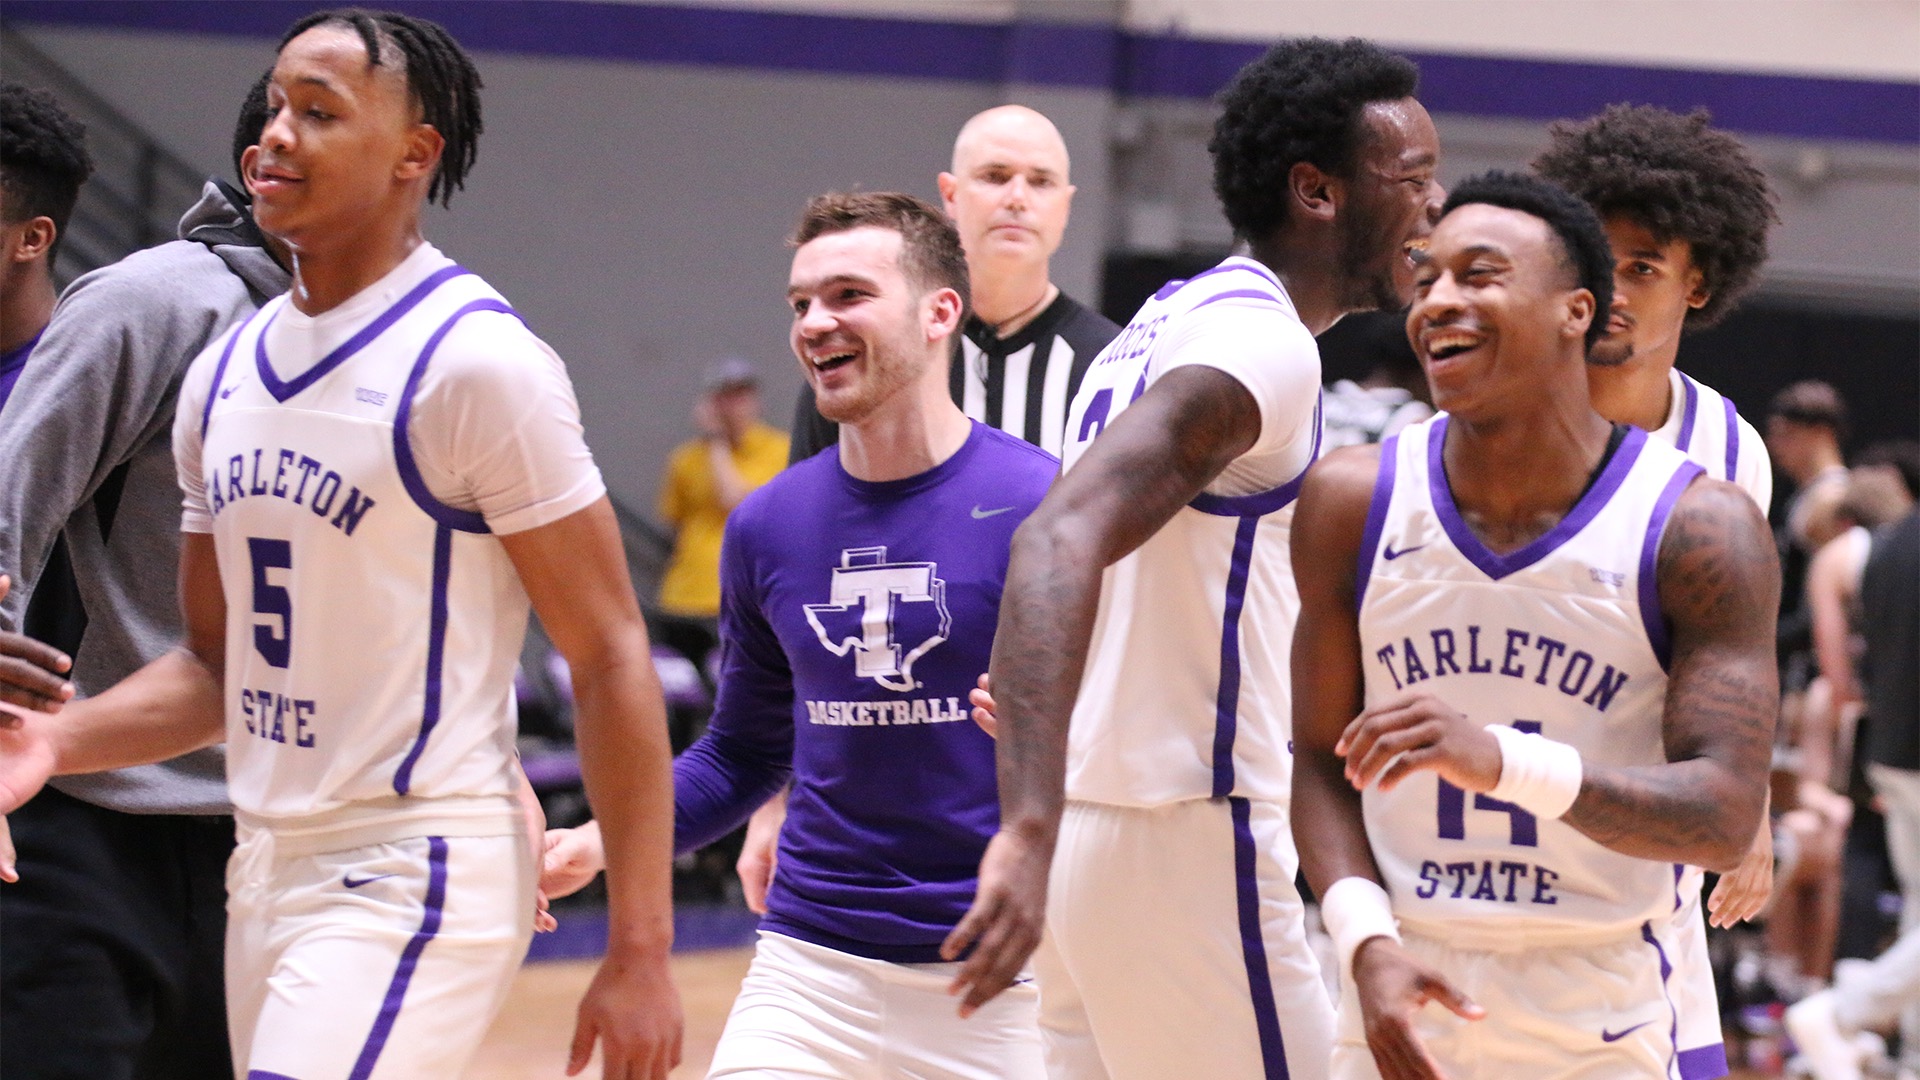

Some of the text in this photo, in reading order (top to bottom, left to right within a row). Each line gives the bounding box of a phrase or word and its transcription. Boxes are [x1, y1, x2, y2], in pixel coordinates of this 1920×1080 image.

[205, 448, 376, 537] ARLETON
[247, 537, 292, 669] 5
[830, 562, 937, 677] T
[1376, 626, 1629, 713] TARLETON
[242, 688, 316, 748] STAE
[1416, 860, 1560, 905] STATE
